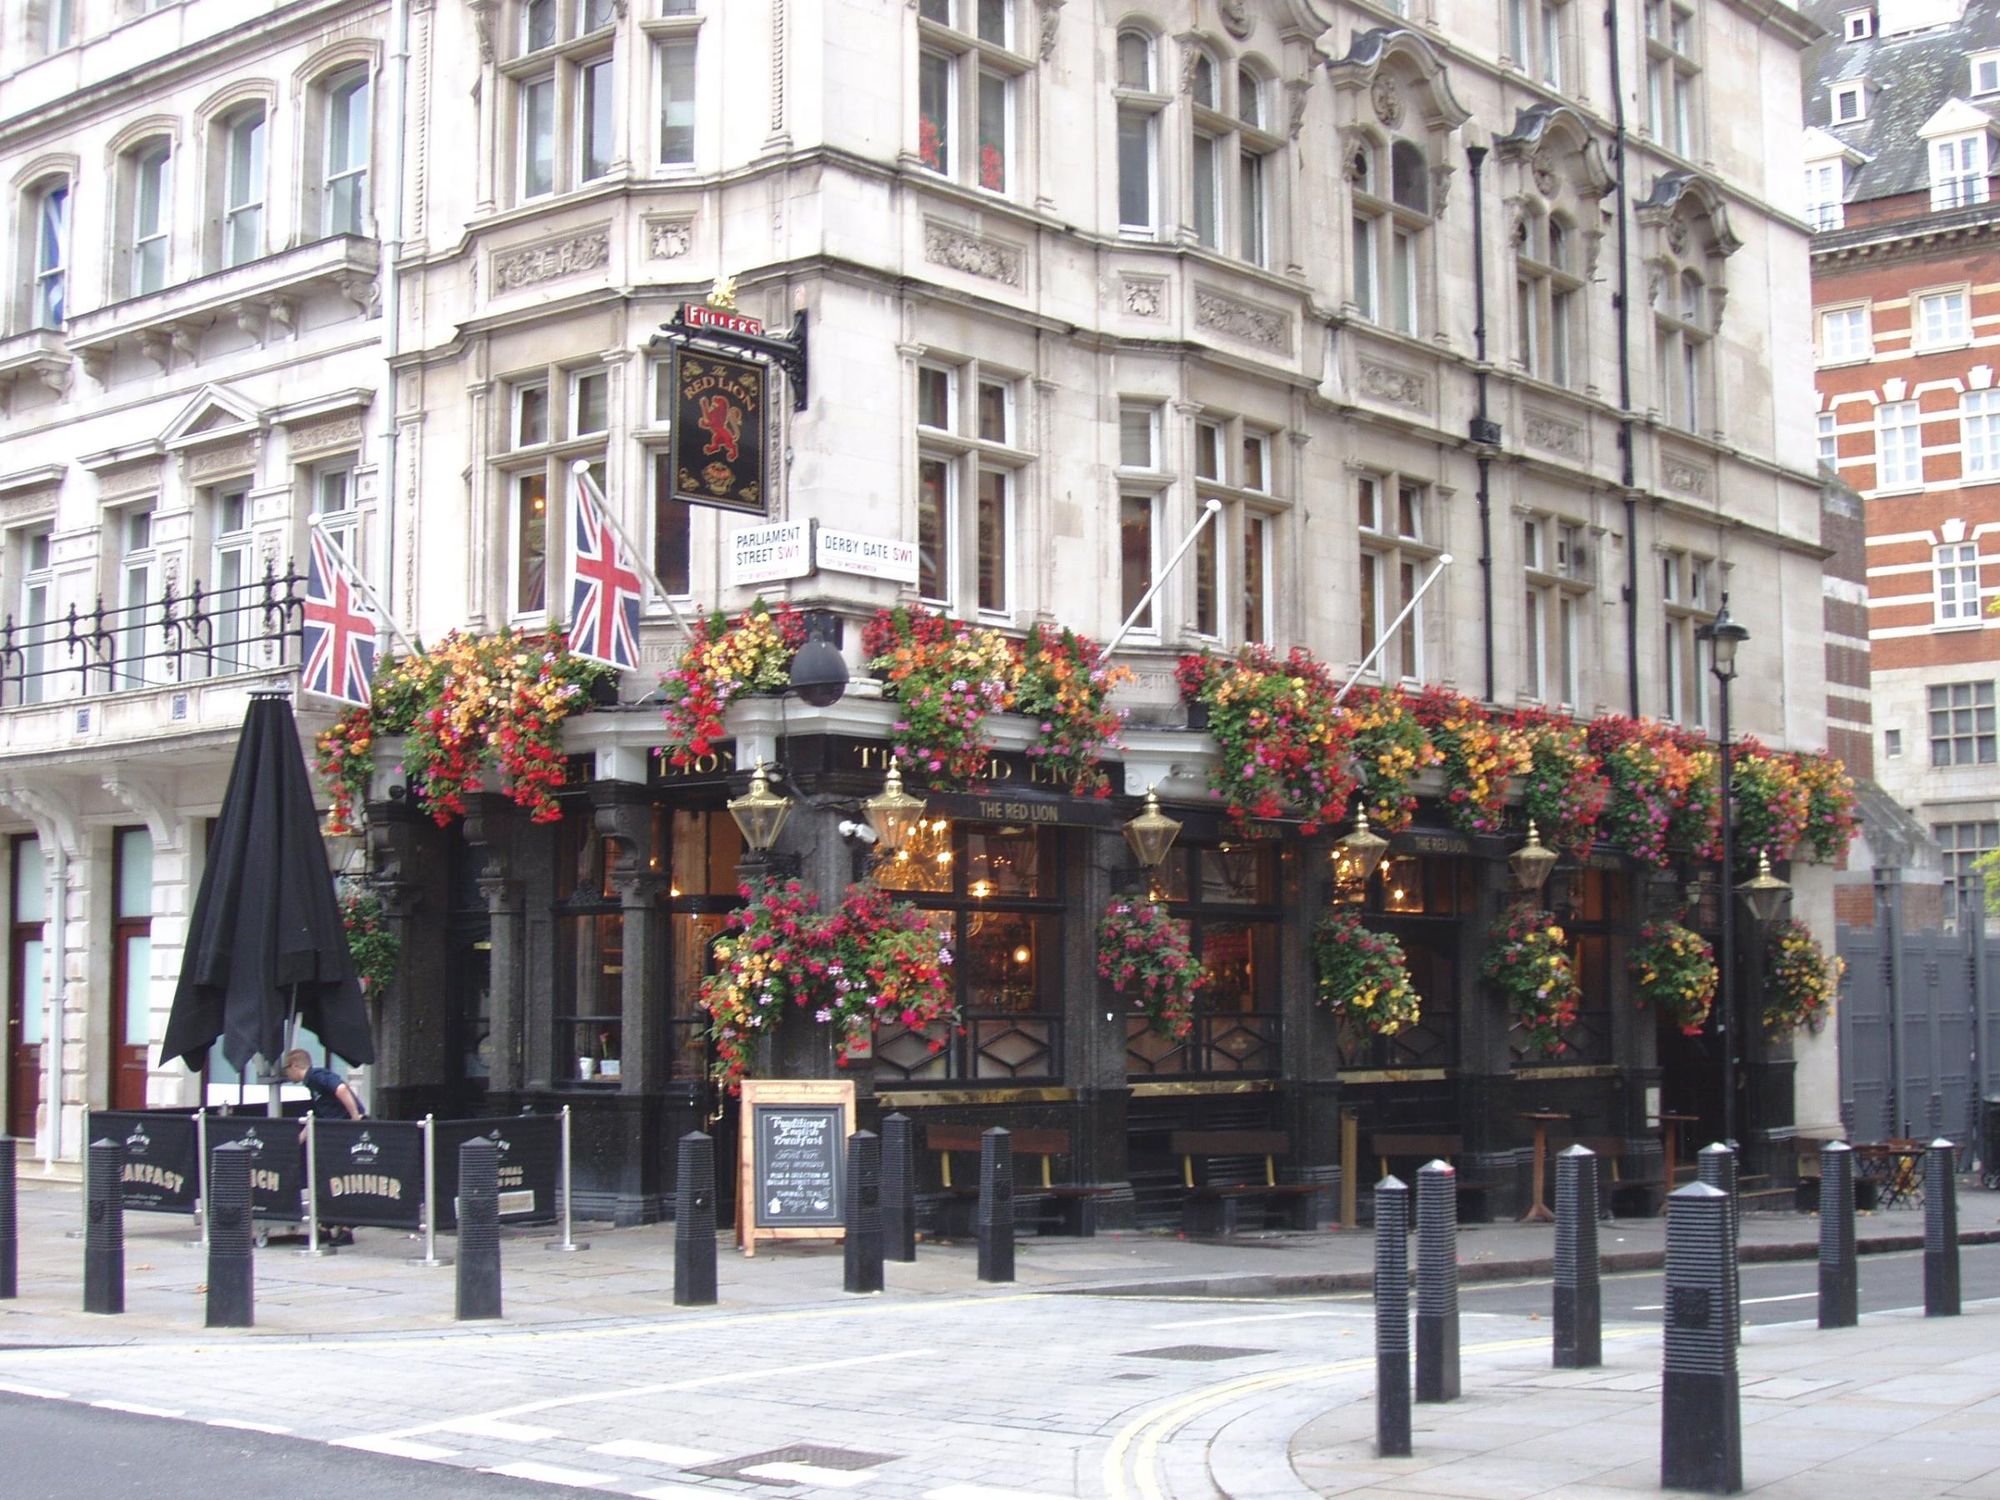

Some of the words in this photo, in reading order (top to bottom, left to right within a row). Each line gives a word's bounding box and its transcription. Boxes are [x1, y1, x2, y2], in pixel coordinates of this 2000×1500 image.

[684, 376, 715, 400] RED
[718, 377, 756, 412] LION
[736, 526, 800, 549] PARLIAMENT
[825, 535, 859, 554] DERBY
[863, 541, 888, 560] GATE
[892, 546, 913, 563] SW1
[736, 547, 774, 566] STREET
[777, 544, 800, 560] SW1
[979, 801, 1003, 819] THE
[1005, 803, 1029, 820] RED
[1031, 804, 1058, 822] LION
[120, 1163, 184, 1194] AKFAST
[329, 1173, 402, 1200] DINNER
